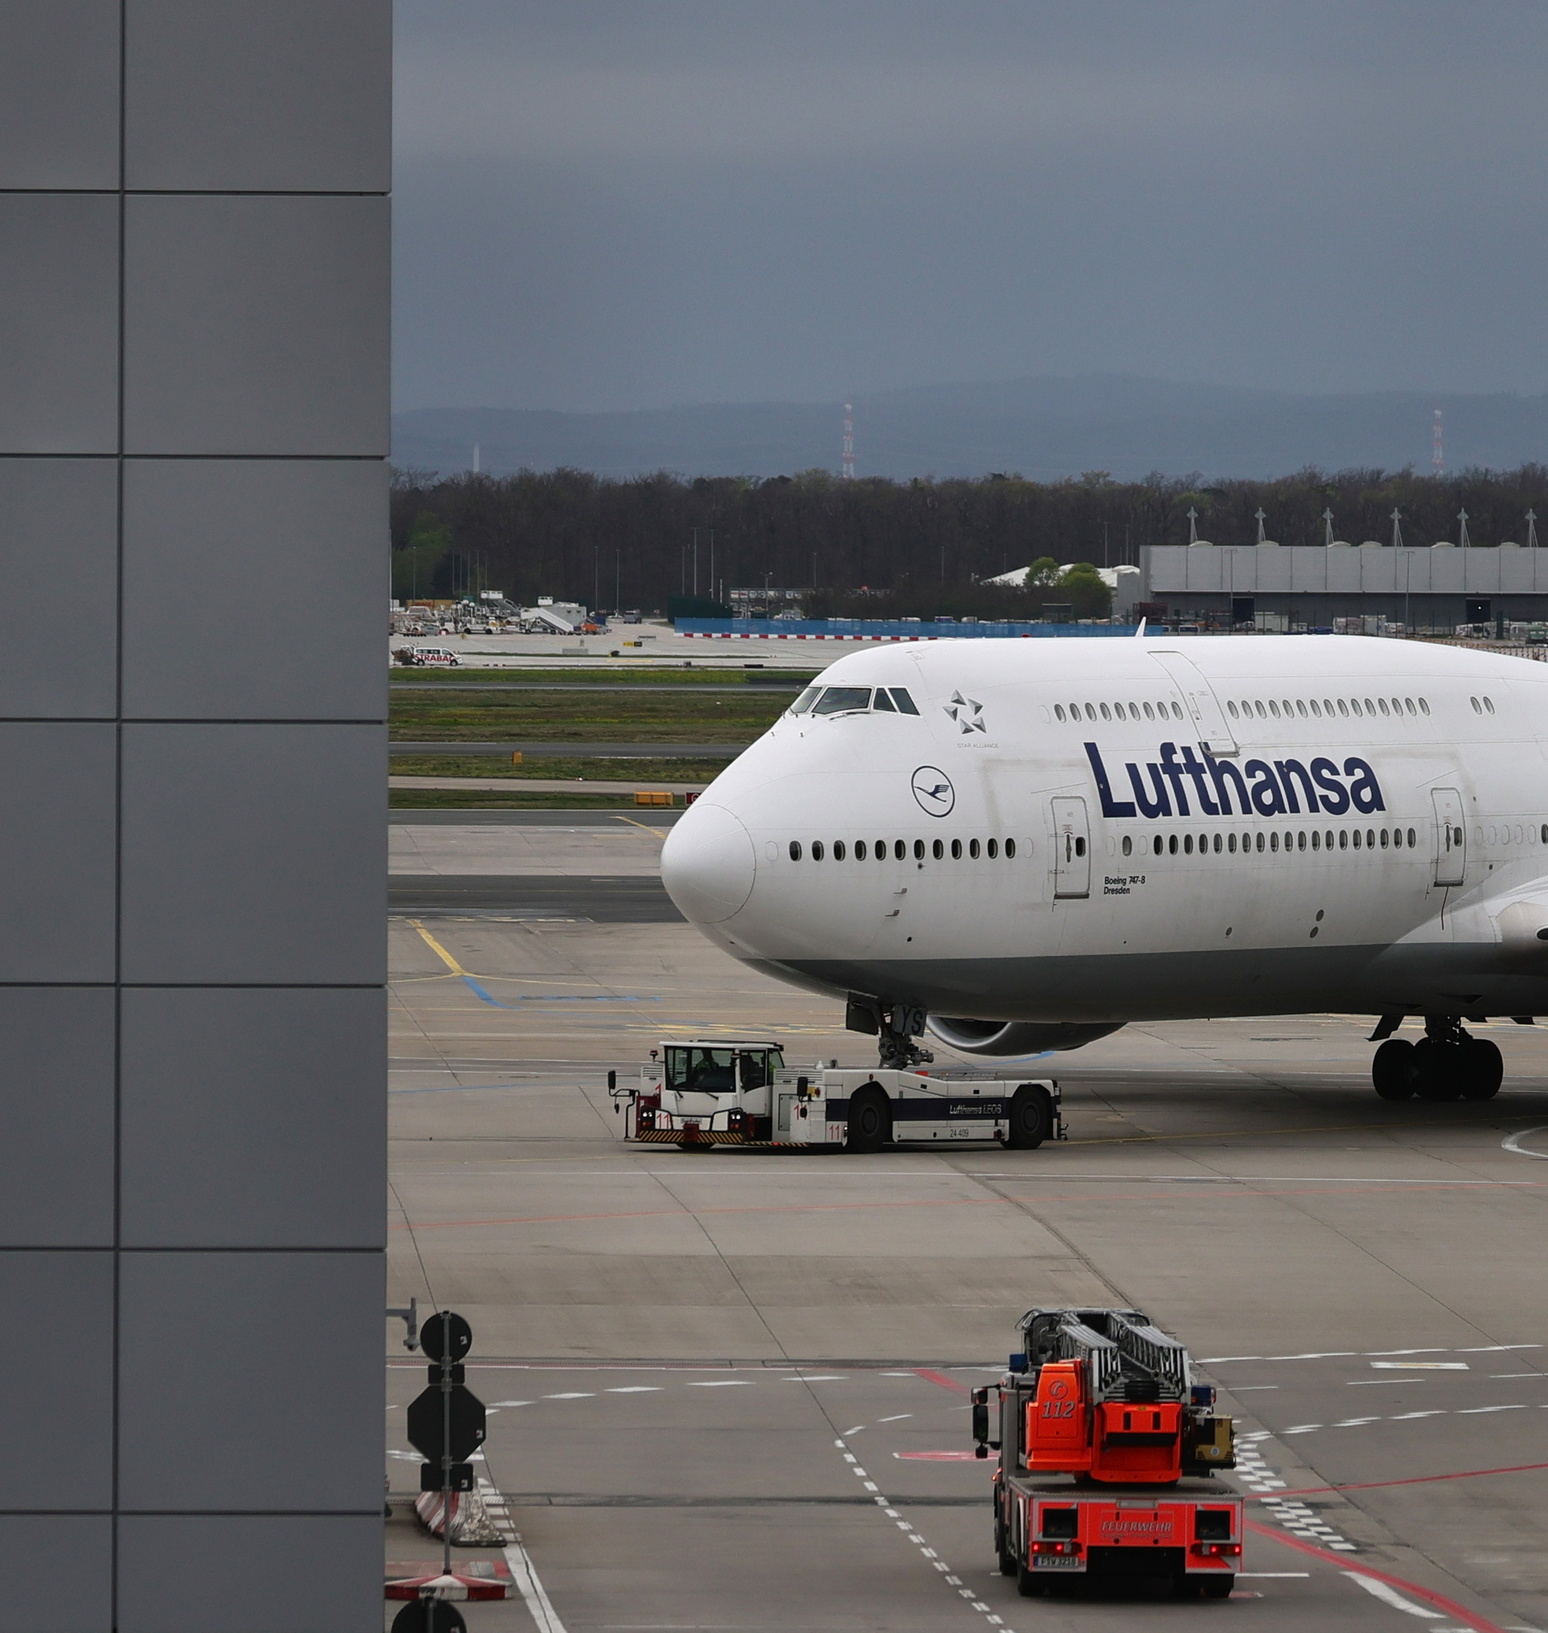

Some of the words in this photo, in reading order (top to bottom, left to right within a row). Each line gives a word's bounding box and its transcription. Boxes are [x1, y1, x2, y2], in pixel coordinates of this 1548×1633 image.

[1083, 741, 1386, 819] Lufthansa
[1104, 876, 1127, 886] Boeing
[1128, 875, 1146, 884] 747-8
[1103, 886, 1131, 895] Dresden
[902, 1005, 923, 1036] YS
[656, 1113, 670, 1129] 11
[829, 1124, 840, 1140] 11
[1042, 1401, 1076, 1419] 112
[1101, 1521, 1173, 1532] FEUERWEHR
